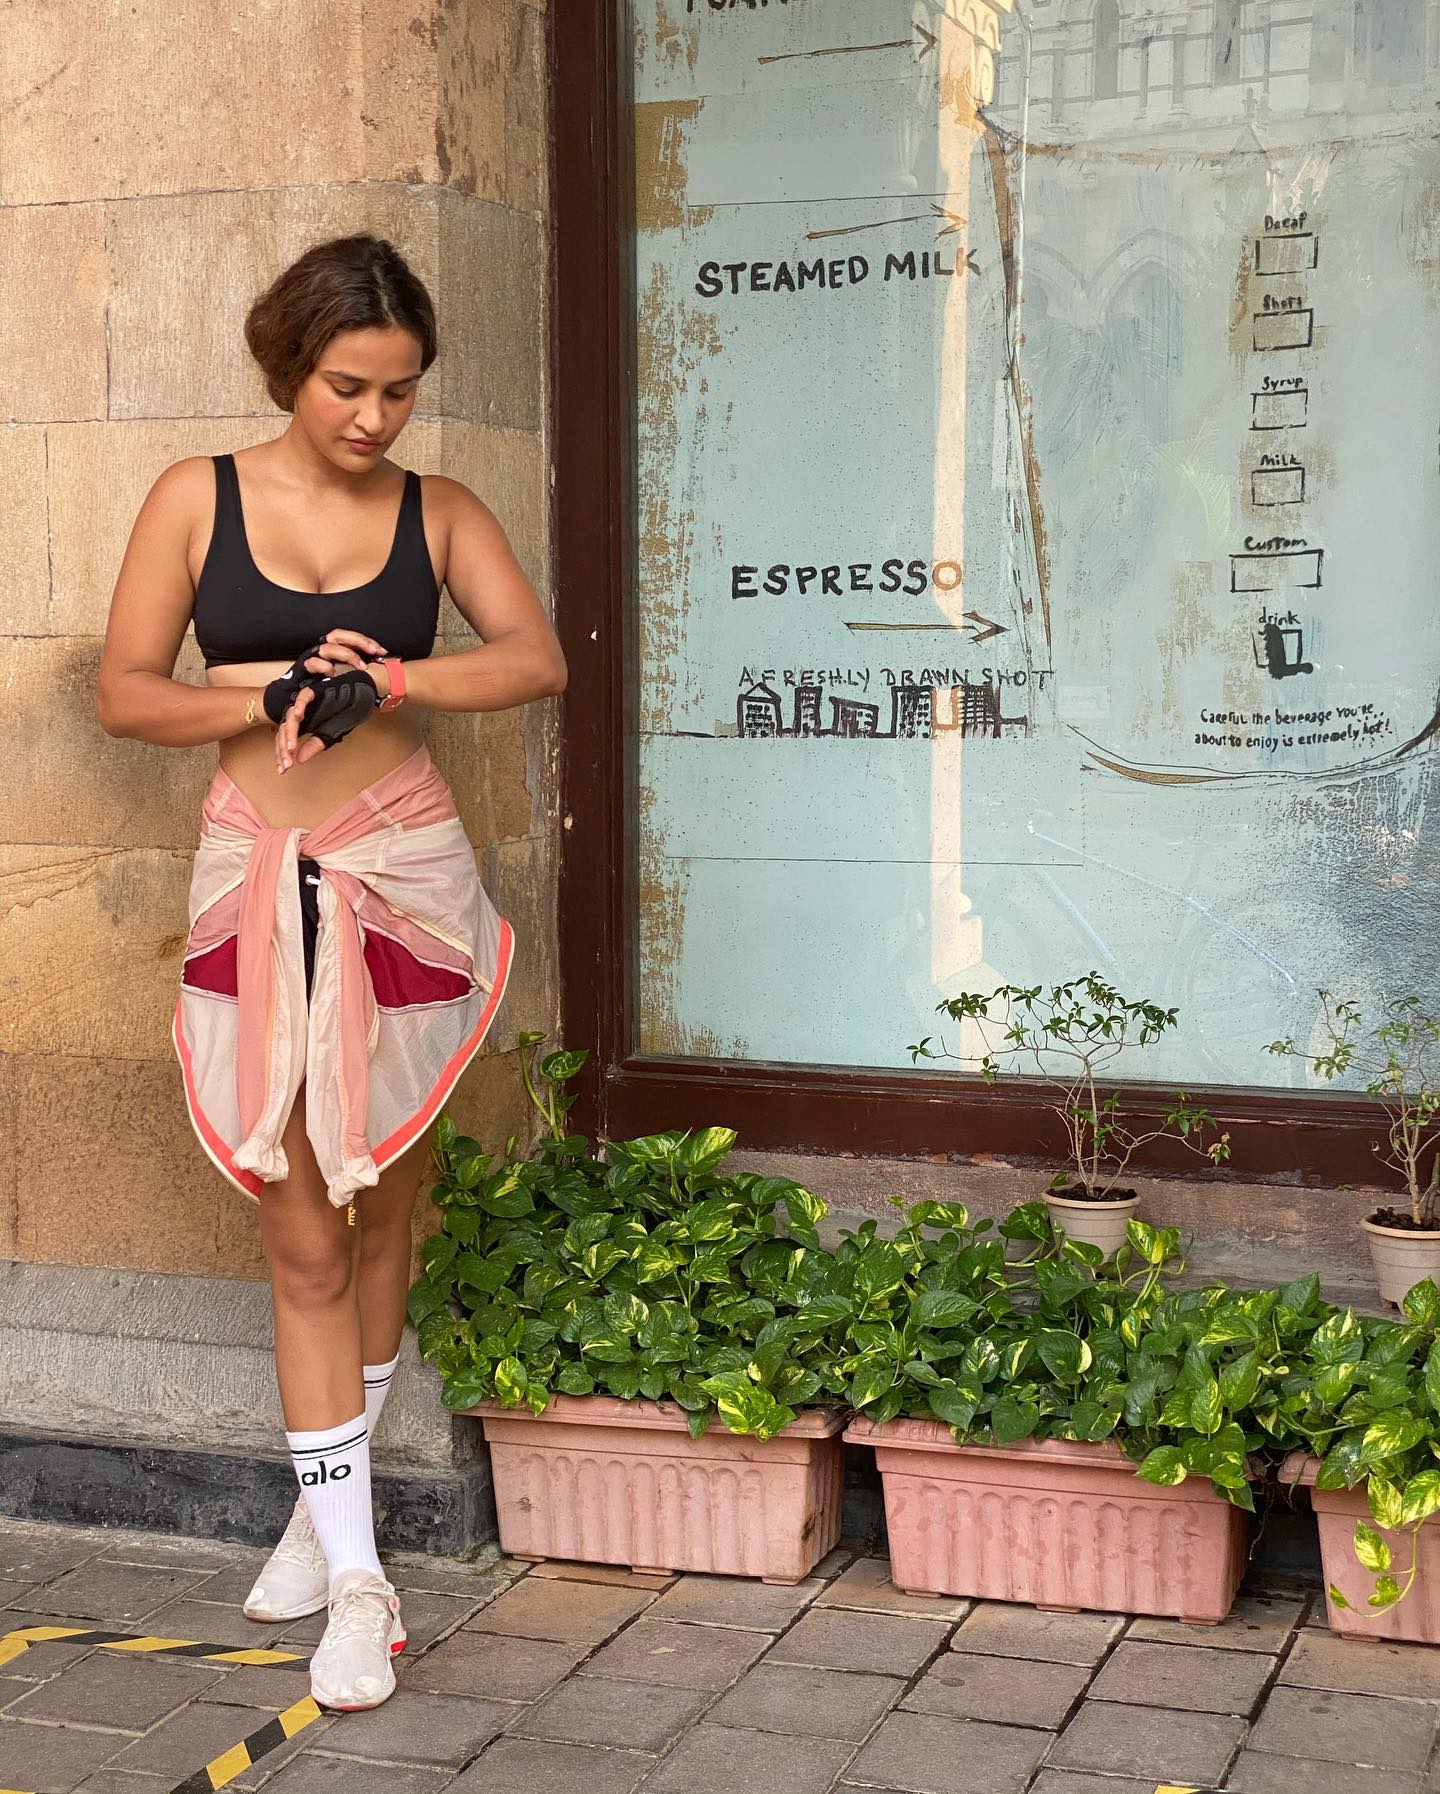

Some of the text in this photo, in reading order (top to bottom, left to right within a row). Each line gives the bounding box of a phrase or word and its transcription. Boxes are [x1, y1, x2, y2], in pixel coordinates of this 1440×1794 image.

[1264, 211, 1307, 232] Decaf
[695, 247, 982, 298] STEAMED MILK
[1262, 376, 1303, 391] Syrup
[731, 559, 963, 599] ESPRESSO
[1258, 606, 1301, 625] drink
[738, 665, 1054, 692] A FRESHLY DRAWN SHOT
[1194, 717, 1390, 753] about to enjoy is extremely hot!
[301, 1460, 352, 1487] alo
